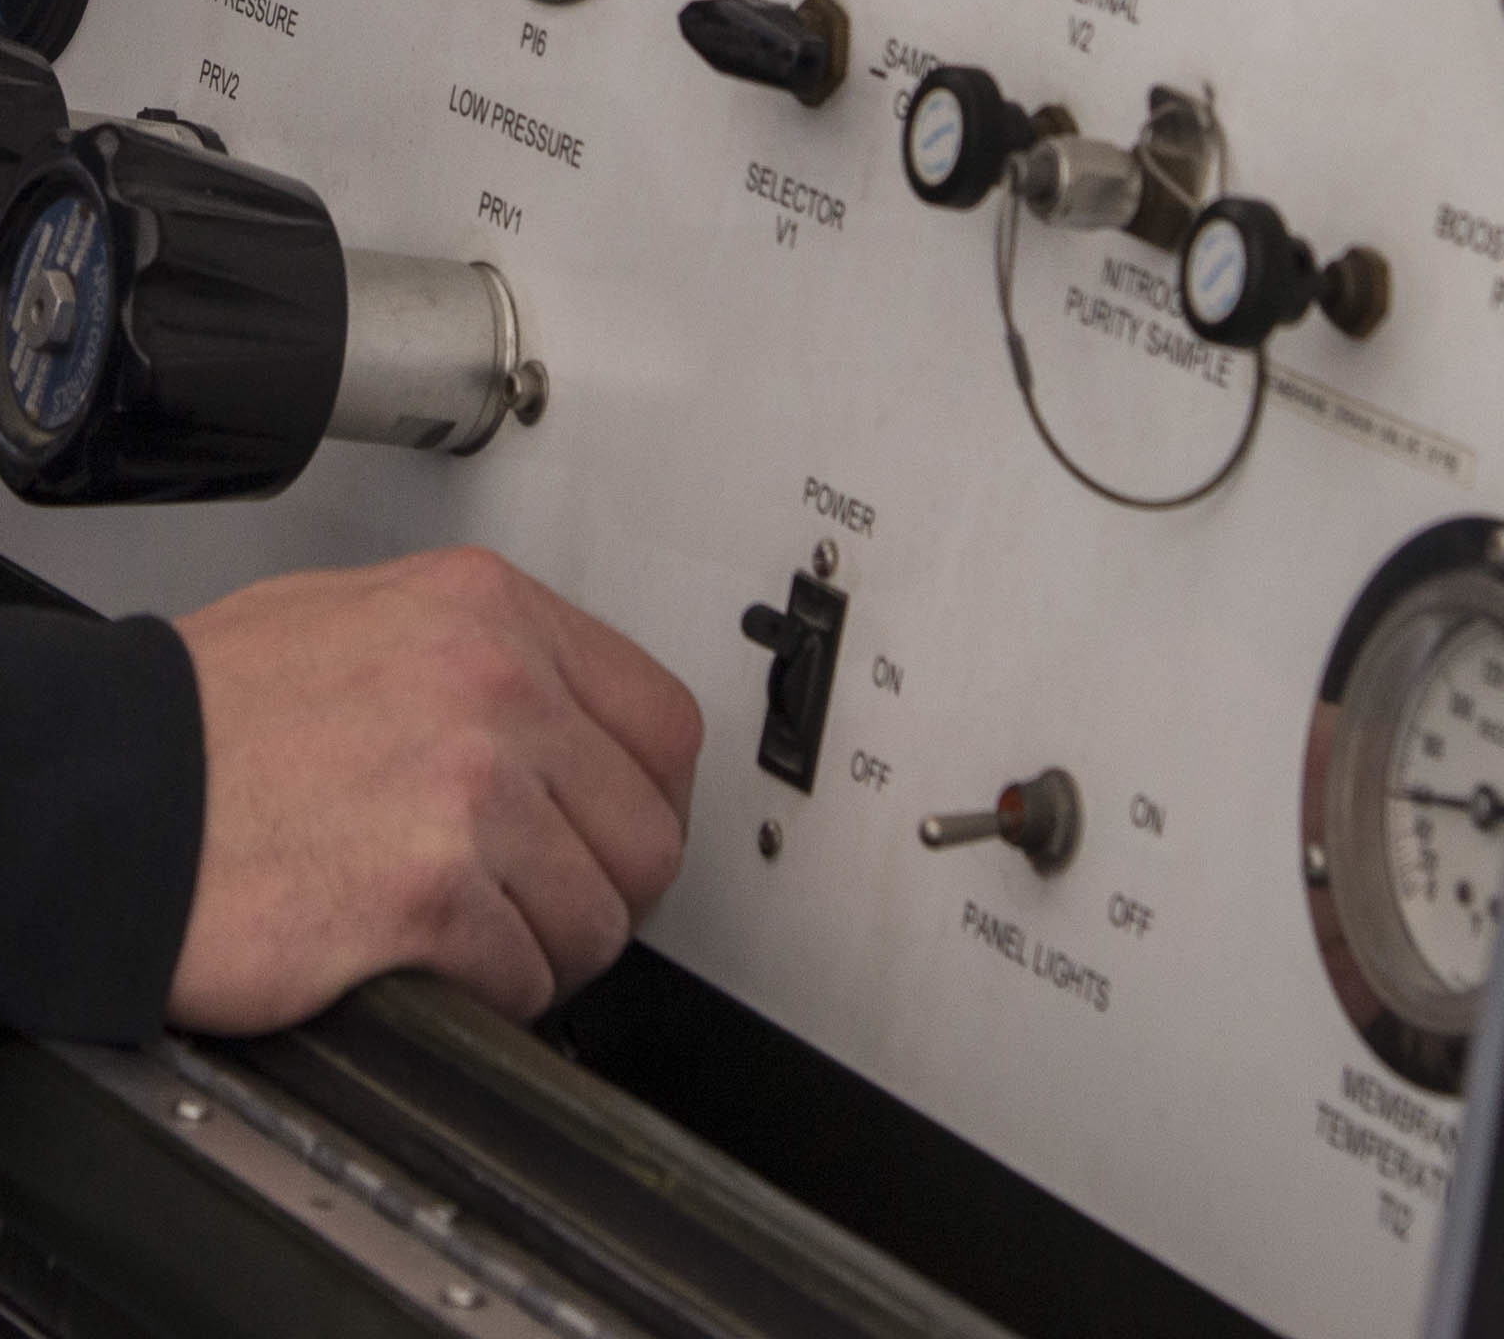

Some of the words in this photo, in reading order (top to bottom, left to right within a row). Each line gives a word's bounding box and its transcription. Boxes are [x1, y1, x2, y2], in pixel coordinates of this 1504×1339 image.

[1069, 17, 1094, 54] V2
[199, 58, 240, 101] PRV2
[449, 84, 491, 125] LOW
[490, 102, 585, 169] PRESSURE
[478, 190, 522, 233] PRV1
[745, 161, 847, 232] SELECTOR
[775, 215, 799, 249] V1
[1064, 285, 1148, 354] PURITY
[1144, 321, 1235, 391] SAMPLE
[803, 476, 876, 536] POWER
[871, 655, 904, 696] ON
[850, 749, 891, 791] OFF
[1131, 794, 1165, 836] ON
[1108, 893, 1154, 935] OFF
[962, 900, 1026, 967] PANEL
[1031, 943, 1111, 1013] LIGHTS
